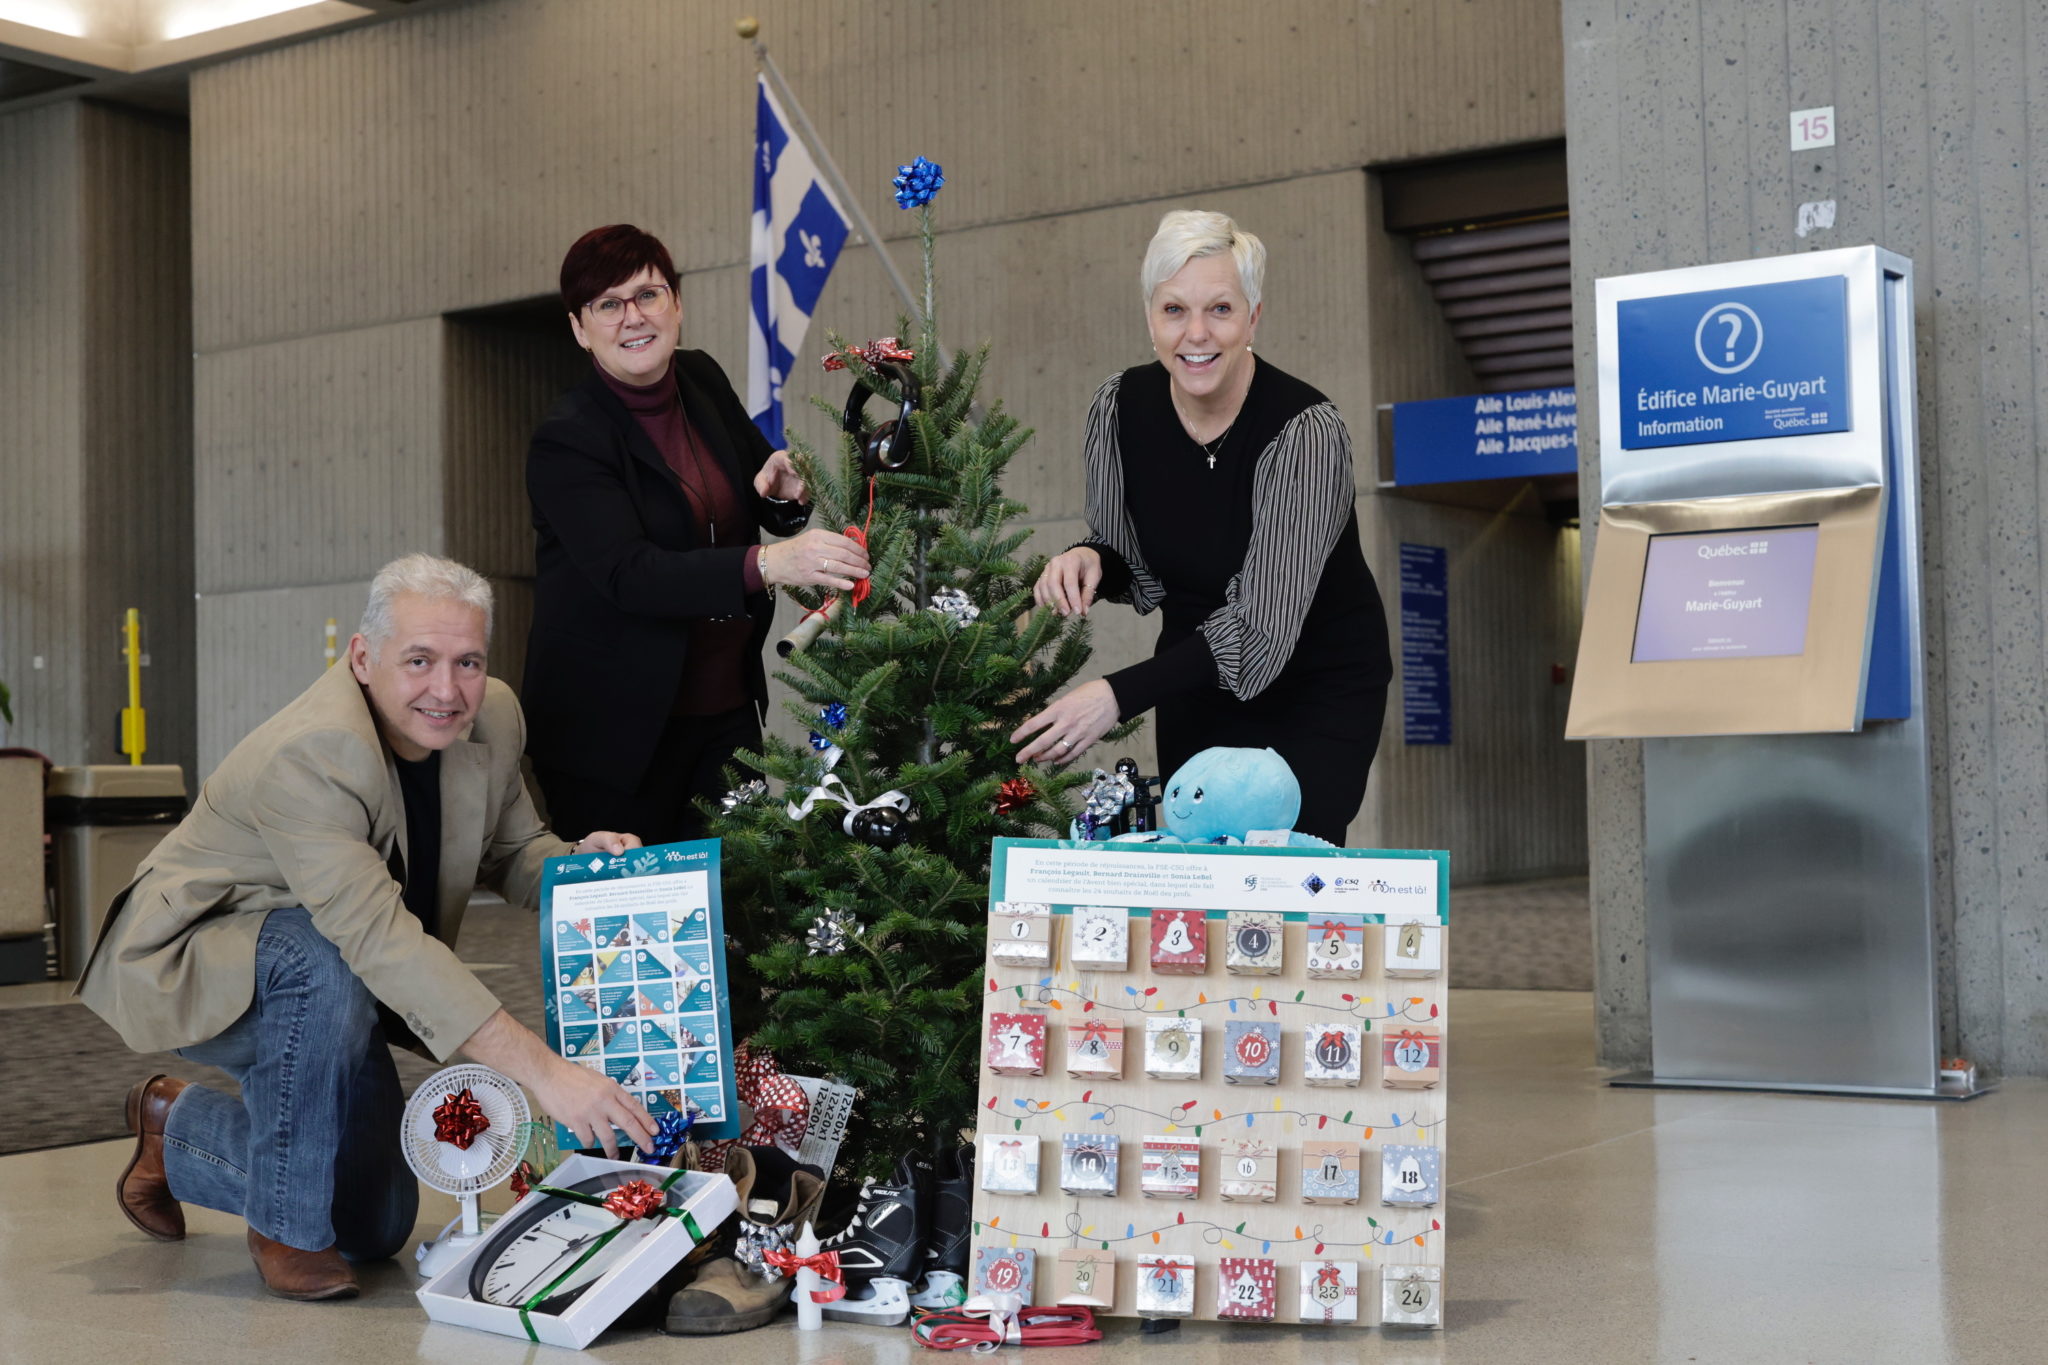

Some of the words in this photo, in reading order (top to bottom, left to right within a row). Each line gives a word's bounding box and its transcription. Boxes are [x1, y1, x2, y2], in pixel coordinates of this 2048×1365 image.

[1798, 116, 1829, 142] 15
[1637, 387, 1697, 411] Édifice
[1702, 376, 1827, 406] Marie-Guyart
[1475, 397, 1503, 414] Aile
[1475, 418, 1504, 435] Aile
[1638, 416, 1724, 437] Information
[1773, 416, 1811, 430] Québec
[1476, 438, 1504, 455] Aile
[1698, 544, 1748, 559] Québec
[1685, 597, 1762, 612] Marie-Guyart
[1344, 878, 1360, 886] CSQ
[1398, 885, 1413, 894] est
[1414, 884, 1427, 895] là!
[1017, 923, 1023, 937] 1
[1093, 926, 1107, 942] 2
[1171, 930, 1182, 946] 3
[1249, 933, 1258, 949] 4
[1406, 934, 1414, 947] 6
[1330, 940, 1339, 955] 5
[1009, 1035, 1021, 1050] 7
[1090, 1040, 1098, 1055] 8
[1168, 1041, 1179, 1057] 9
[1244, 1042, 1262, 1058] 10
[1325, 1046, 1340, 1062] 11
[1404, 1049, 1421, 1063] 12
[1081, 1157, 1096, 1173] 14
[1242, 1162, 1252, 1174] 16
[1162, 1167, 1179, 1181] 15
[1324, 1165, 1337, 1181] 17
[1402, 1171, 1418, 1184] 18
[997, 1267, 1013, 1284] 19
[1076, 1271, 1090, 1282] 20
[1158, 1278, 1174, 1293] 21
[1238, 1285, 1255, 1300] 22
[1318, 1286, 1339, 1299] 23
[1401, 1289, 1423, 1306] 24
